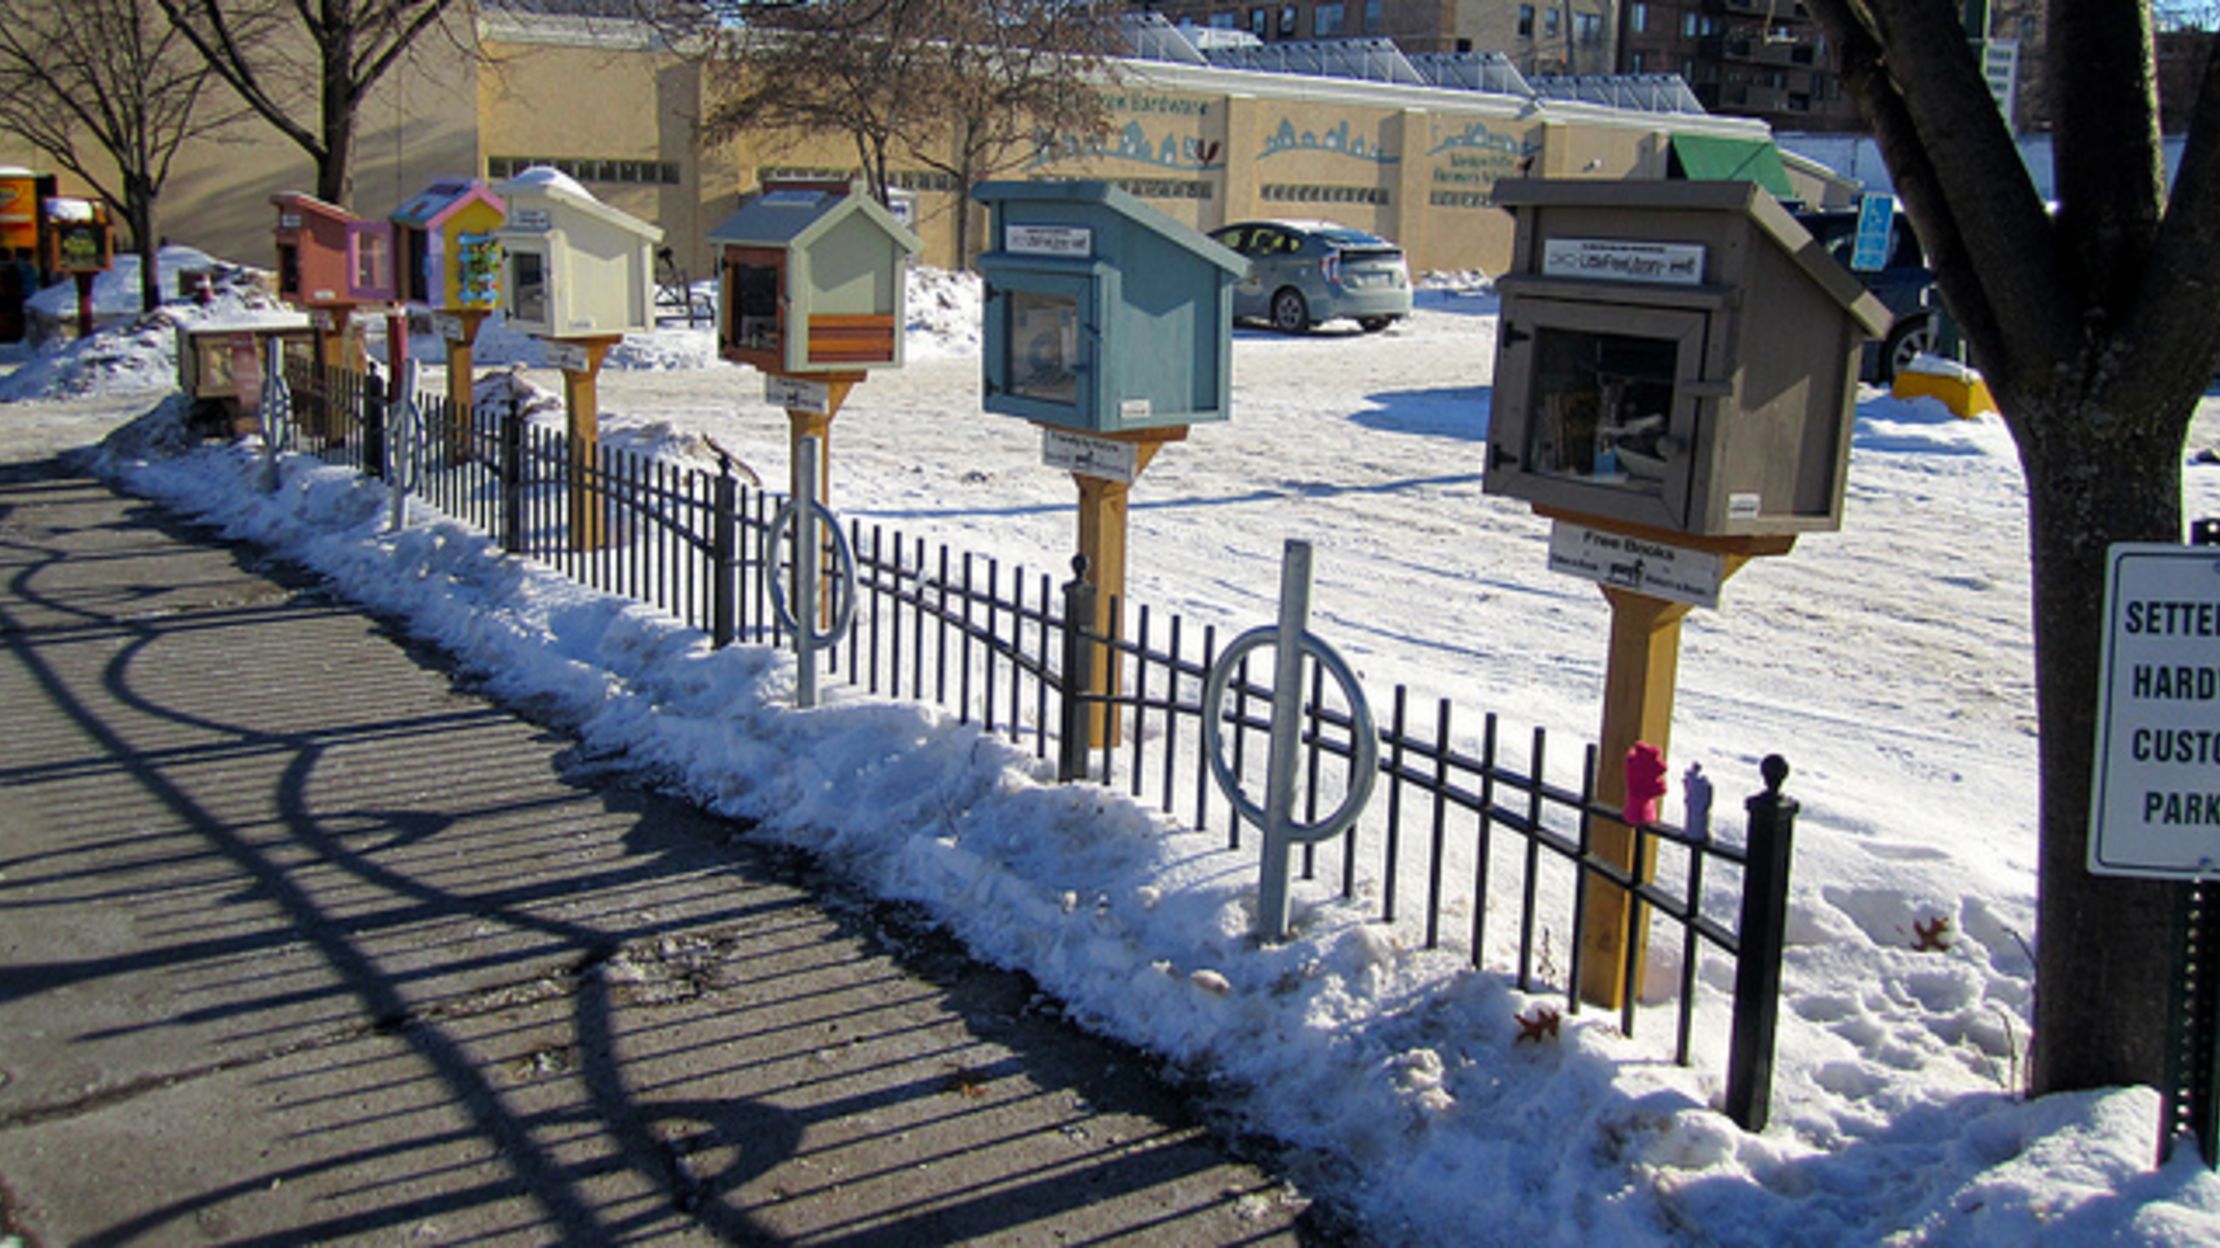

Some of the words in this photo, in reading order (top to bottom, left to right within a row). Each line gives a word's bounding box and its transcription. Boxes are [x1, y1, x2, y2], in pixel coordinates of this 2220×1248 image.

[1584, 531, 1621, 550] Free
[1625, 537, 1676, 560] Books
[2125, 600, 2220, 637] SETTE
[2132, 664, 2220, 700] HARD
